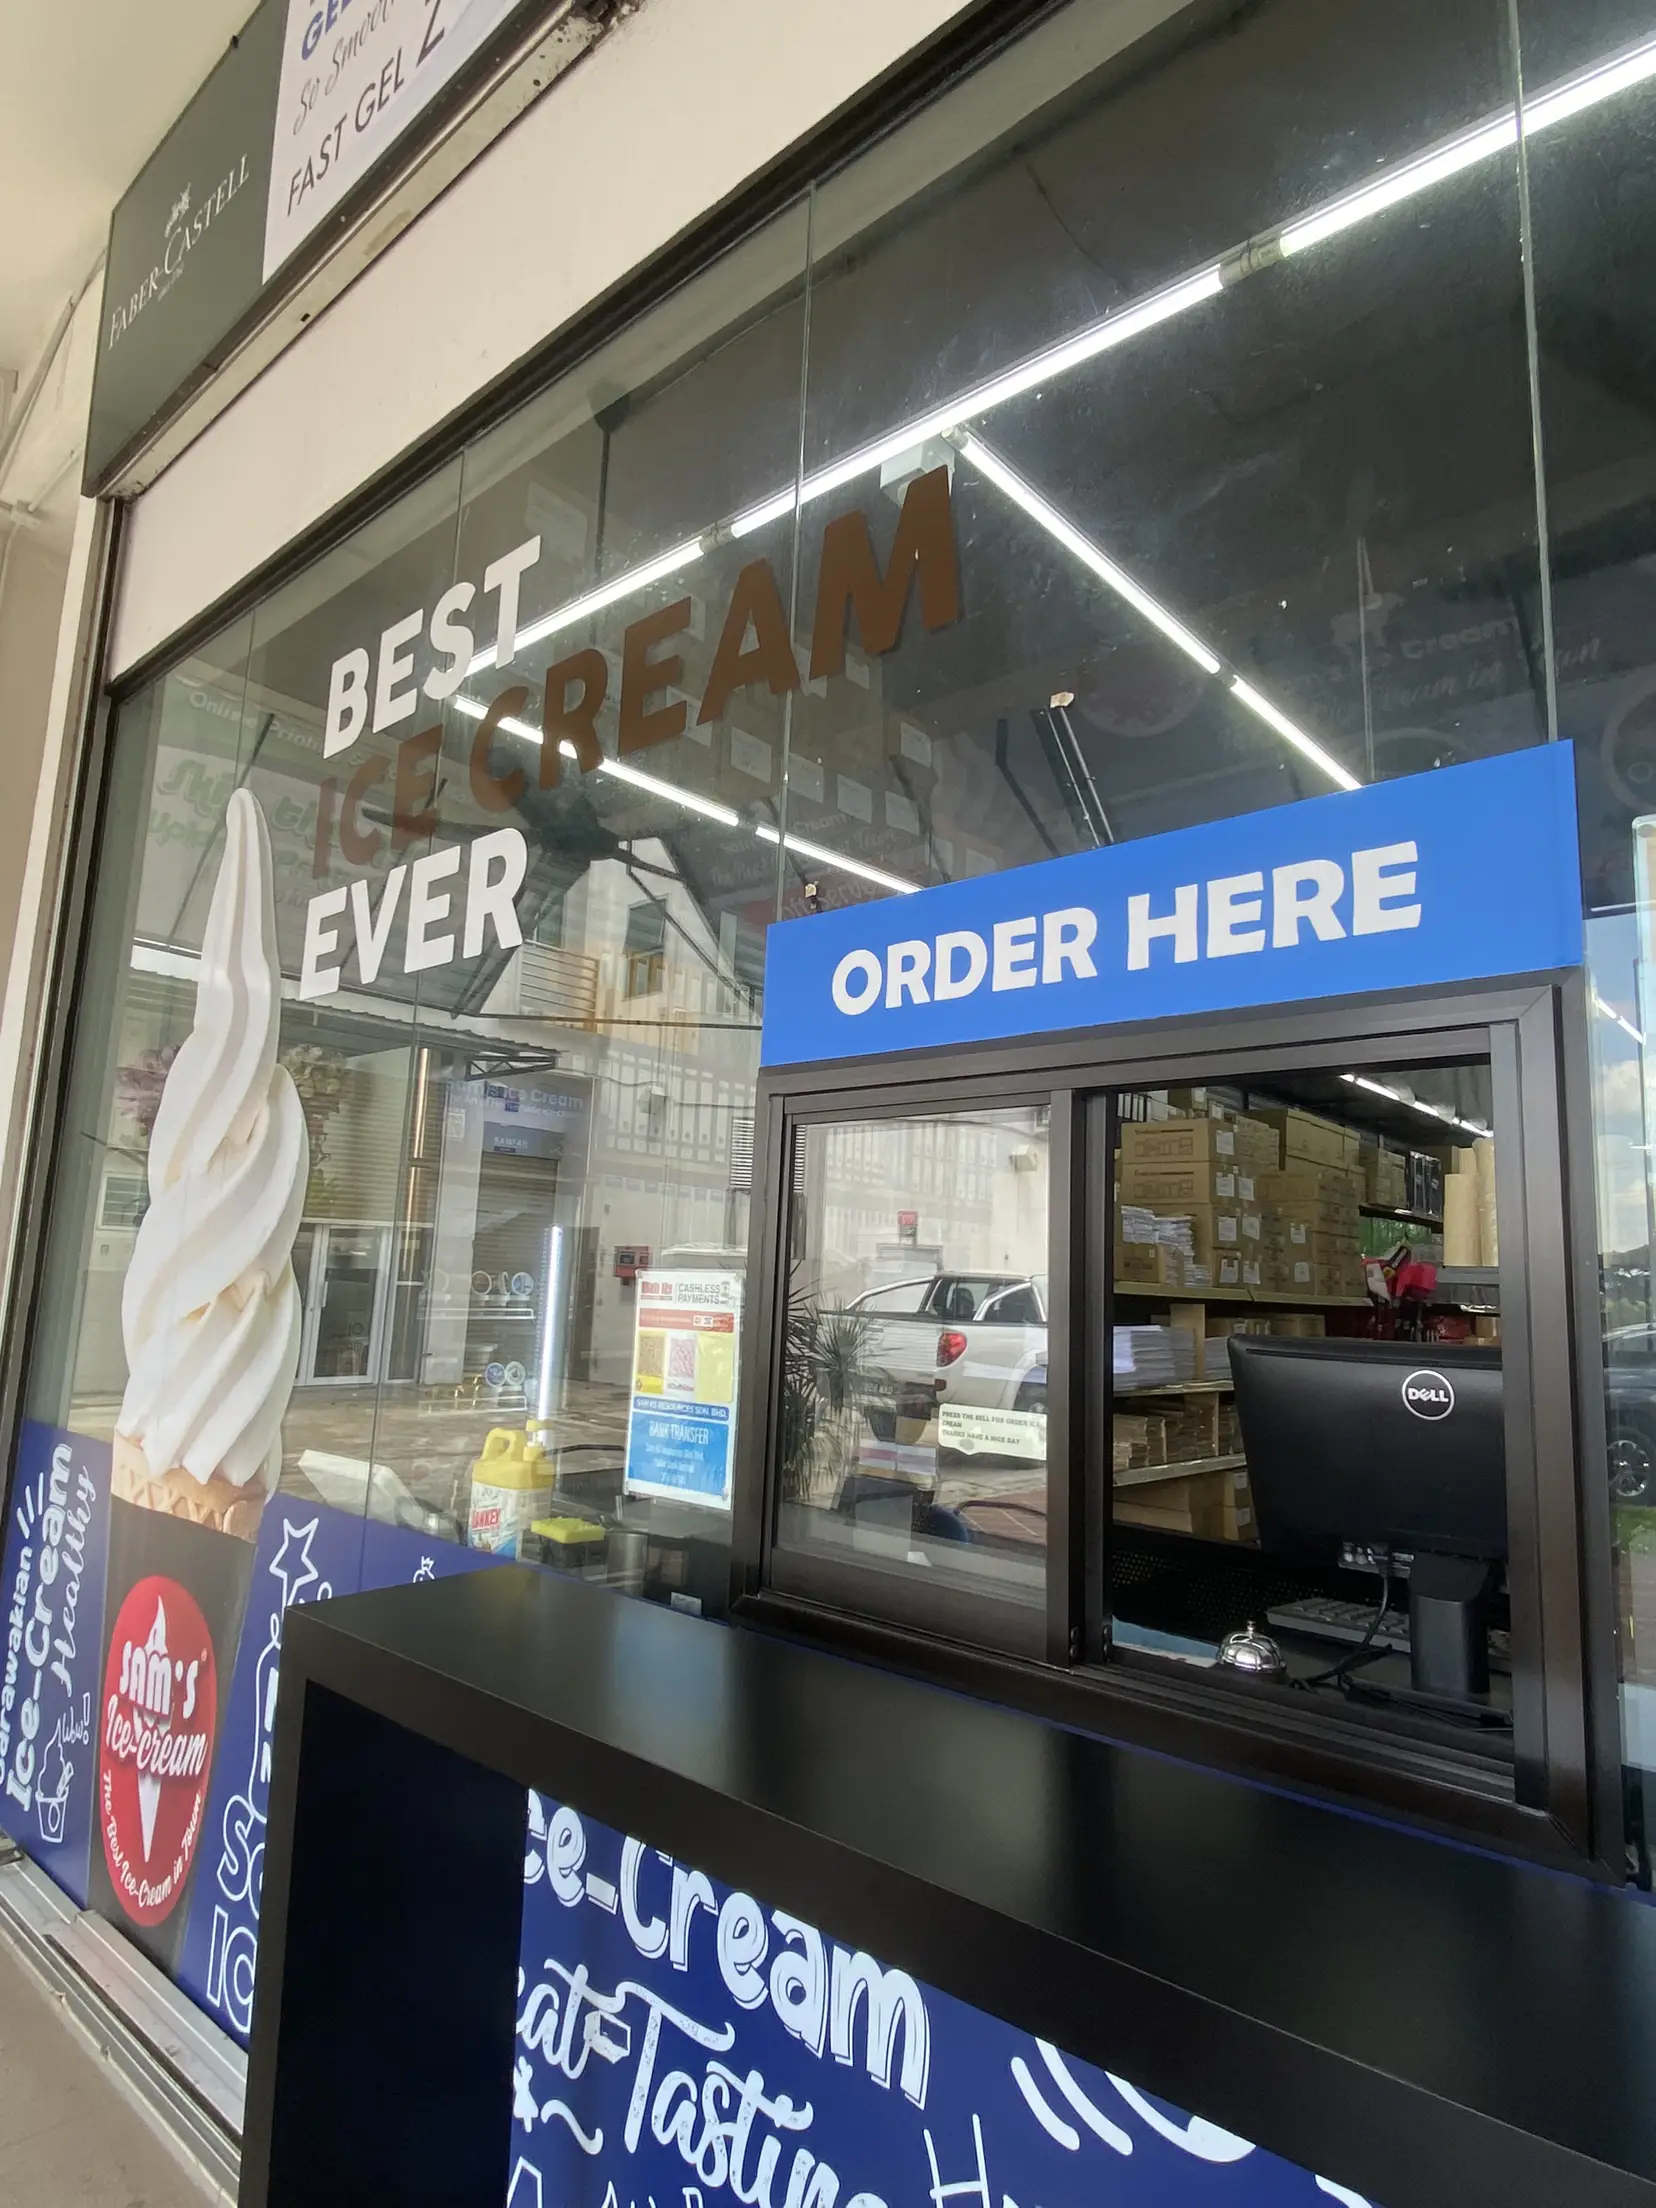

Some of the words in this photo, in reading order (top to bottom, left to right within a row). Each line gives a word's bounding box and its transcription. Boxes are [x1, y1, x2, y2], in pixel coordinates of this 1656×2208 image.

[287, 113, 348, 218] FAST
[355, 47, 405, 133] GEL
[109, 153, 249, 350] FABER-CASTELL
[312, 724, 444, 879] ICE
[469, 465, 961, 812] CREAM
[323, 535, 542, 759] BEST
[300, 828, 528, 1001] EVER
[831, 907, 1098, 1016] ORDER
[1128, 840, 1422, 971] HERE
[678, 1283, 720, 1294] CASHLESS
[678, 1294, 720, 1305] PAYMENTS
[671, 1423, 710, 1445] TRANSFER
[1407, 1386, 1449, 1404] DELL
[6, 1443, 73, 1812] Ice-Cream
[51, 1465, 97, 1697] Healthy
[103, 1769, 112, 1815] The
[107, 1815, 124, 1867] Best
[173, 1855, 183, 1884] in
[180, 1788, 201, 1861] Town
[523, 1788, 930, 2111] ce-Cream
